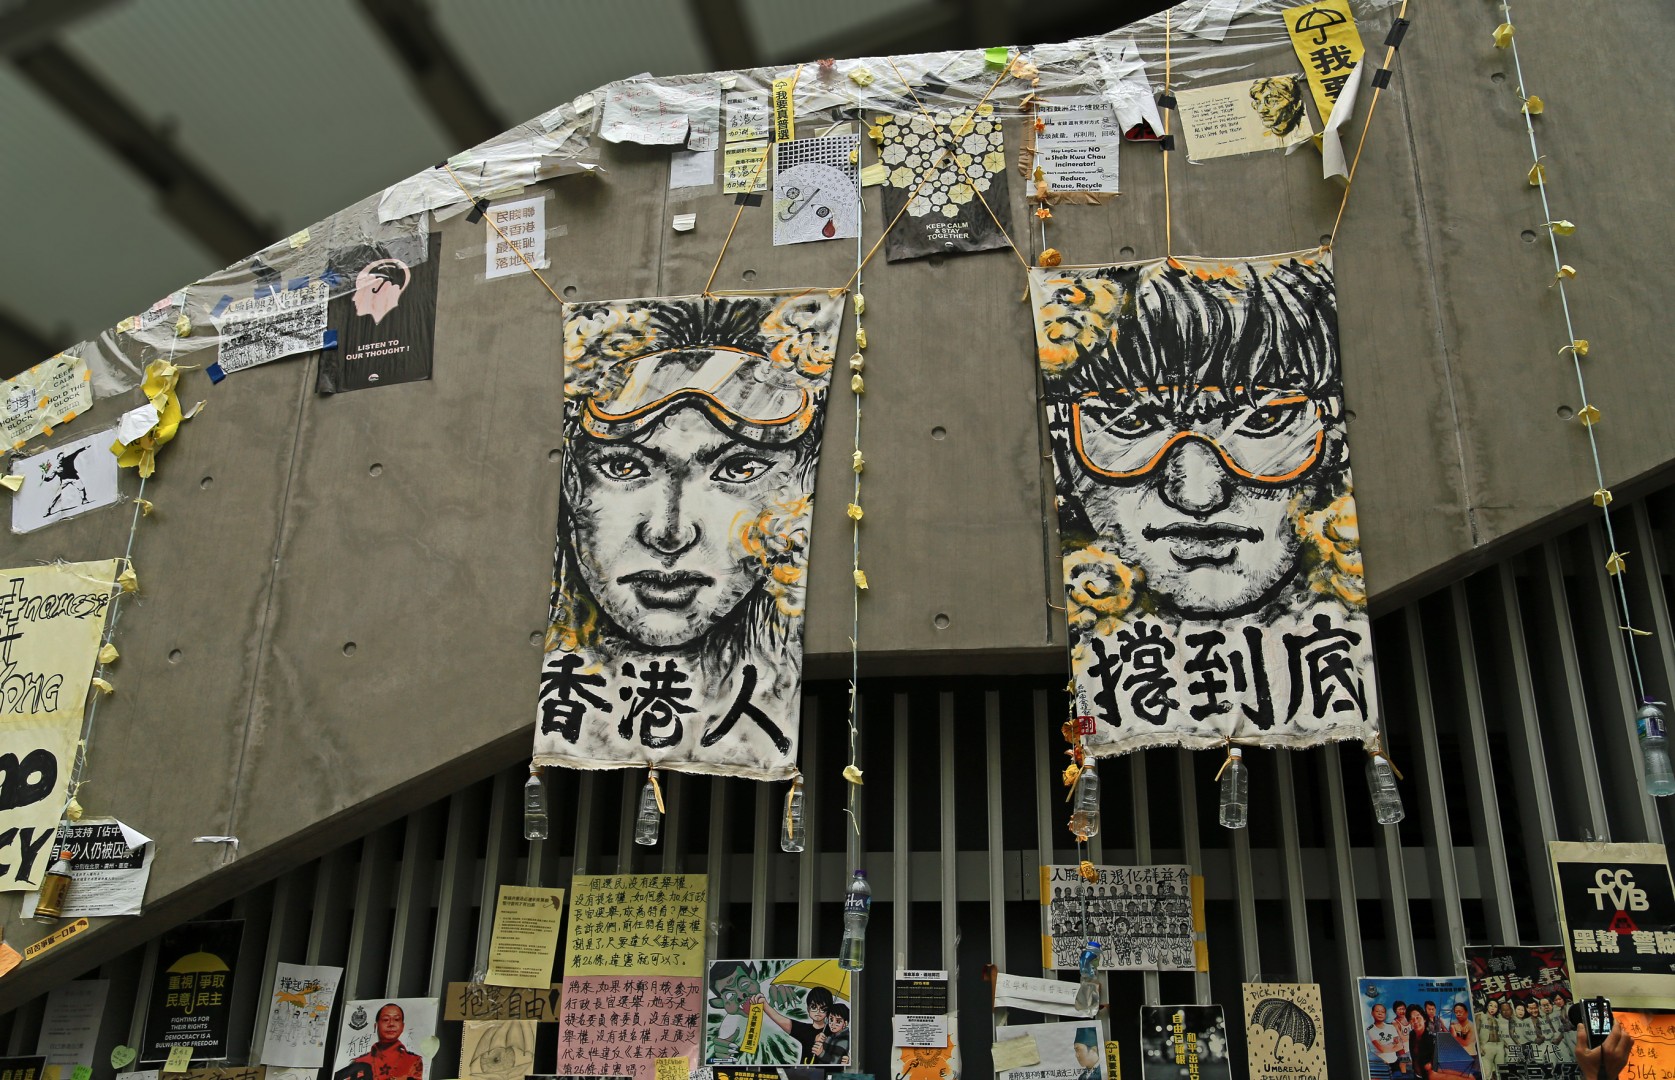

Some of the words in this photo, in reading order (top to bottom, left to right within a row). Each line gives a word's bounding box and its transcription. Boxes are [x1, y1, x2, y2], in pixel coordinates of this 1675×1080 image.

[926, 222, 946, 230] KEEP
[947, 221, 969, 229] CALM
[927, 233, 970, 241] TOGETHER
[357, 342, 386, 352] LISTEN
[387, 339, 400, 349] TO
[345, 352, 364, 361] OUR
[364, 347, 404, 359] THOUGHT
[53, 373, 75, 388] CALM
[47, 390, 69, 405] HOLD
[70, 382, 86, 393] THE
[54, 391, 80, 408] BLOCK
[7, 414, 33, 431] BLOCK
[1087, 613, 1369, 731] 撐到底
[537, 652, 793, 758] 香港人
[845, 893, 865, 908] ita
[1587, 887, 1650, 912] TVB
[168, 974, 194, 990] 重視
[199, 974, 226, 989] 爭取
[165, 992, 191, 1008] 民意
[196, 991, 223, 1006] 民主
[1249, 988, 1272, 1000] PICK
[1277, 988, 1286, 997] IT
[164, 1033, 200, 1041] DEMOCRACY
[190, 1039, 219, 1047] FREEDOM
[1264, 1063, 1311, 1073] UMBRELLA
[1627, 1061, 1657, 1080] 5164
